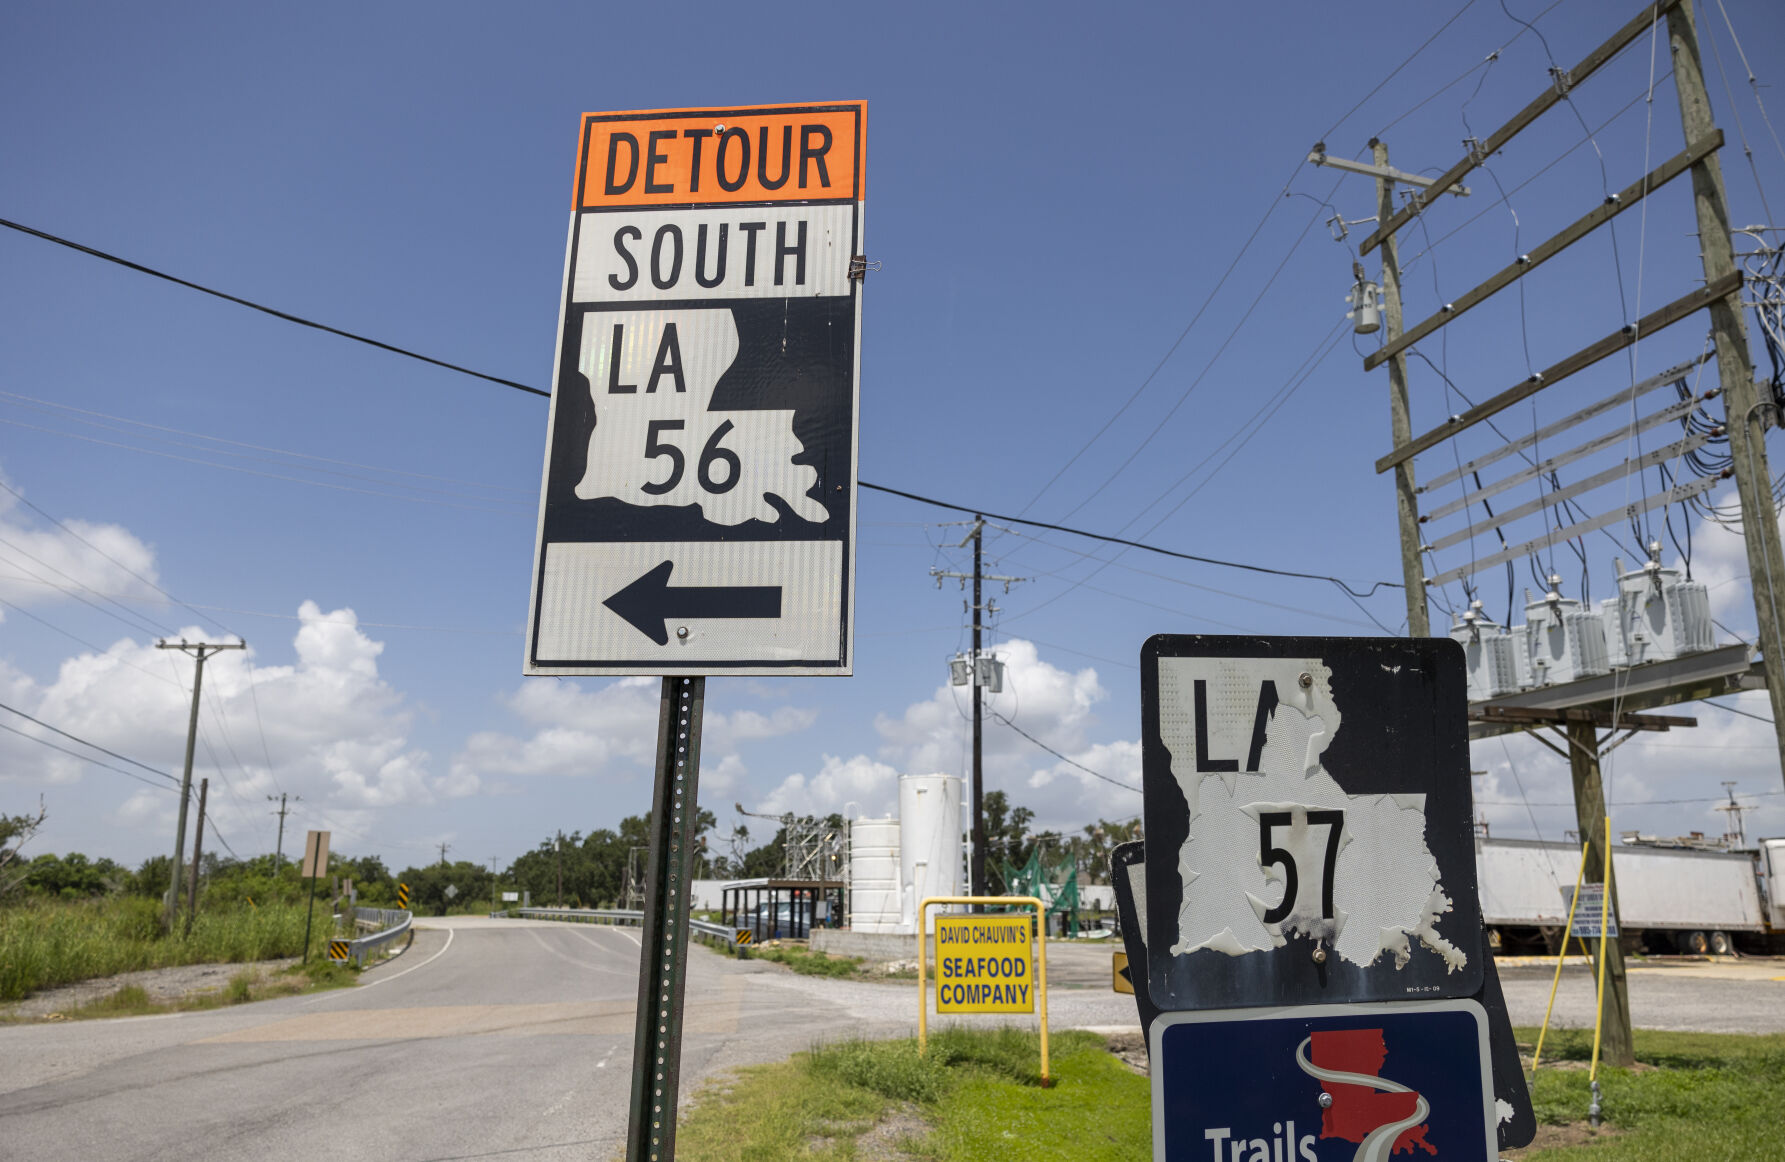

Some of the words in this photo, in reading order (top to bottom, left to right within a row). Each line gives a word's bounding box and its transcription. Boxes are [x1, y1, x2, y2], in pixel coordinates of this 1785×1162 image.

[604, 124, 833, 195] DETOUR
[608, 220, 808, 291] SOUTH
[608, 322, 687, 394] LA
[640, 418, 742, 495] 56
[1259, 810, 1344, 924] 57
[941, 926, 970, 944] DAVID
[972, 925, 1026, 944] CHAUVIN'S
[943, 957, 1026, 978] SEAFOOD
[941, 983, 1029, 1005] COMPANY
[1204, 1120, 1318, 1162] Trails
